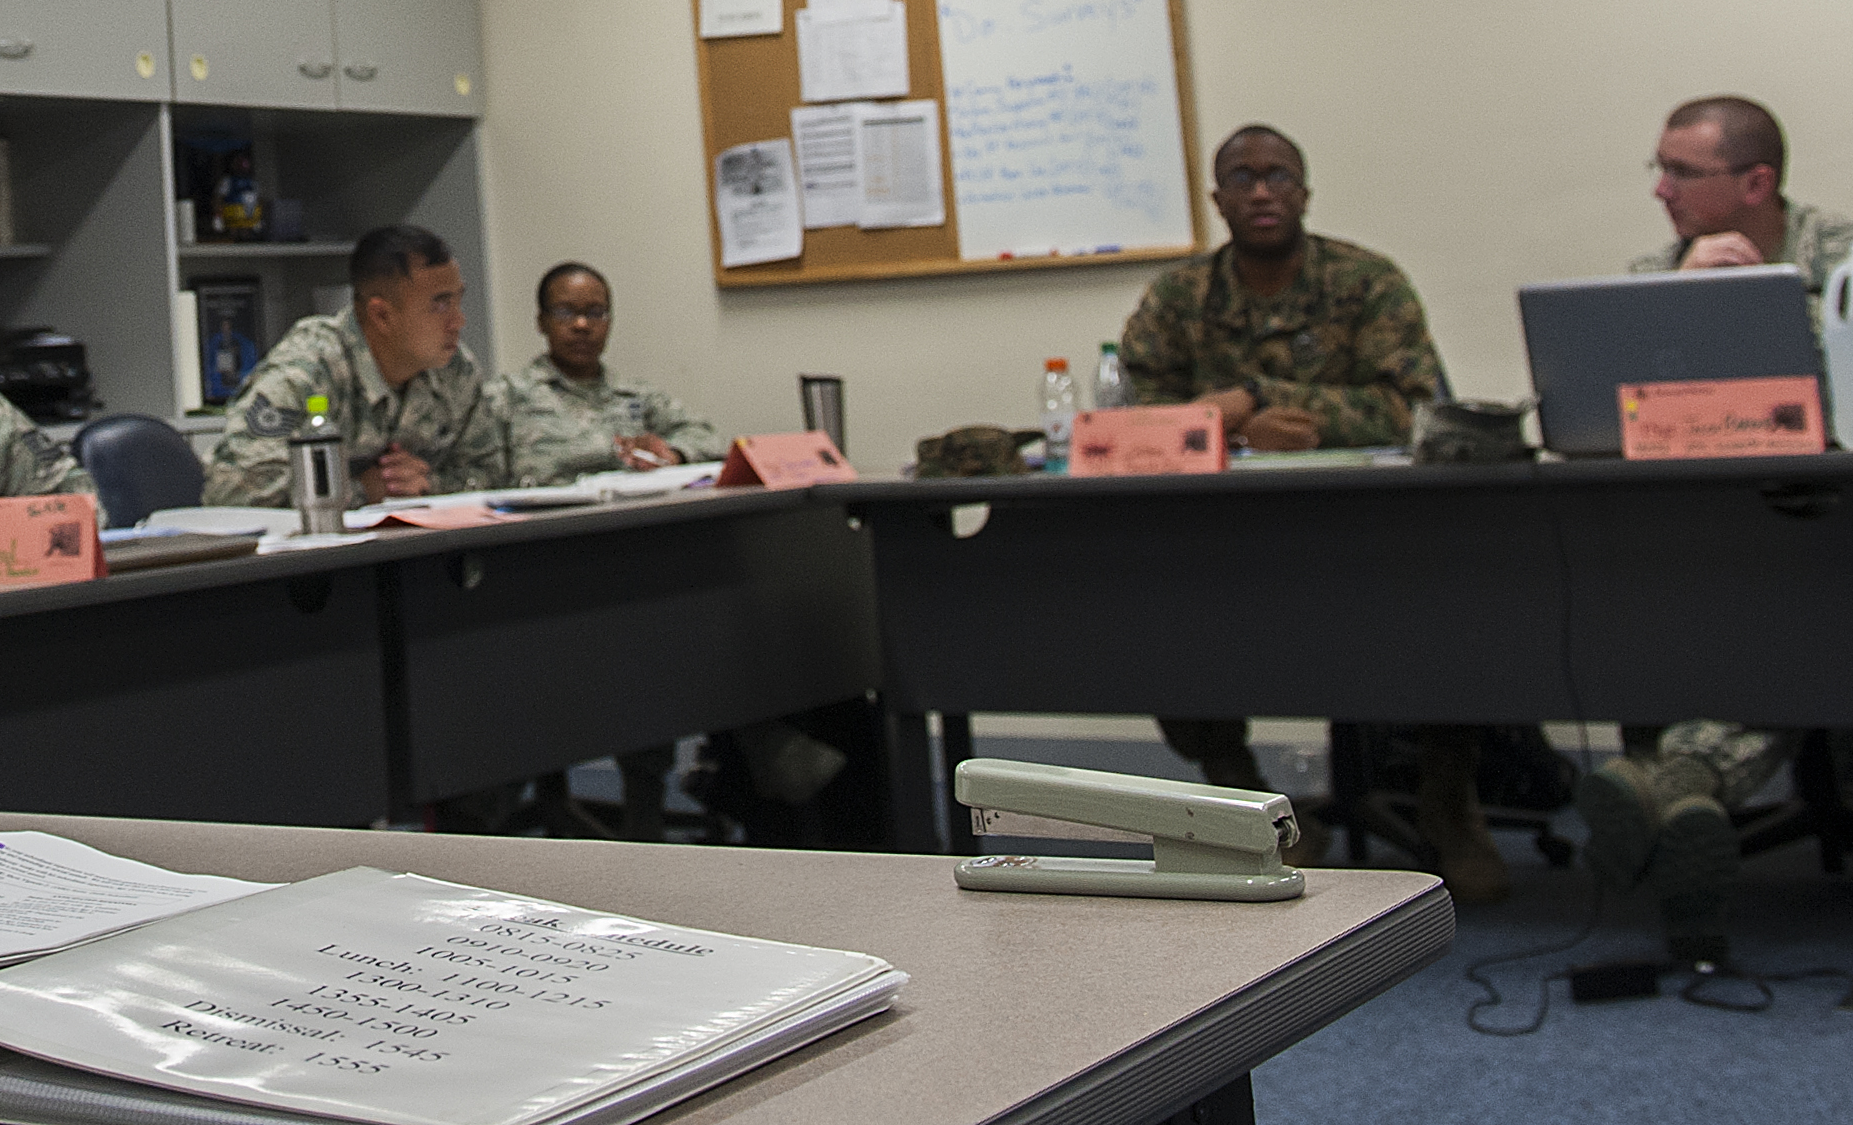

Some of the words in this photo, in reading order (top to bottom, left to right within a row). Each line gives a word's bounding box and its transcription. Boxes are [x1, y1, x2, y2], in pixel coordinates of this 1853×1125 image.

[446, 936, 610, 972] 0910-0920
[480, 924, 642, 960] 0815-0825
[317, 944, 423, 975] Lunch:
[442, 973, 612, 1009] 1100-1215
[415, 946, 579, 984] 1005-1015
[308, 985, 477, 1024] 1355-1405
[345, 971, 510, 1010] 1300-1310
[183, 1000, 345, 1042] Dismissal:
[365, 1040, 450, 1062] 1545
[270, 998, 438, 1038] 1450-1500
[160, 1020, 284, 1054] Retreat:
[305, 1052, 391, 1074] 1555
